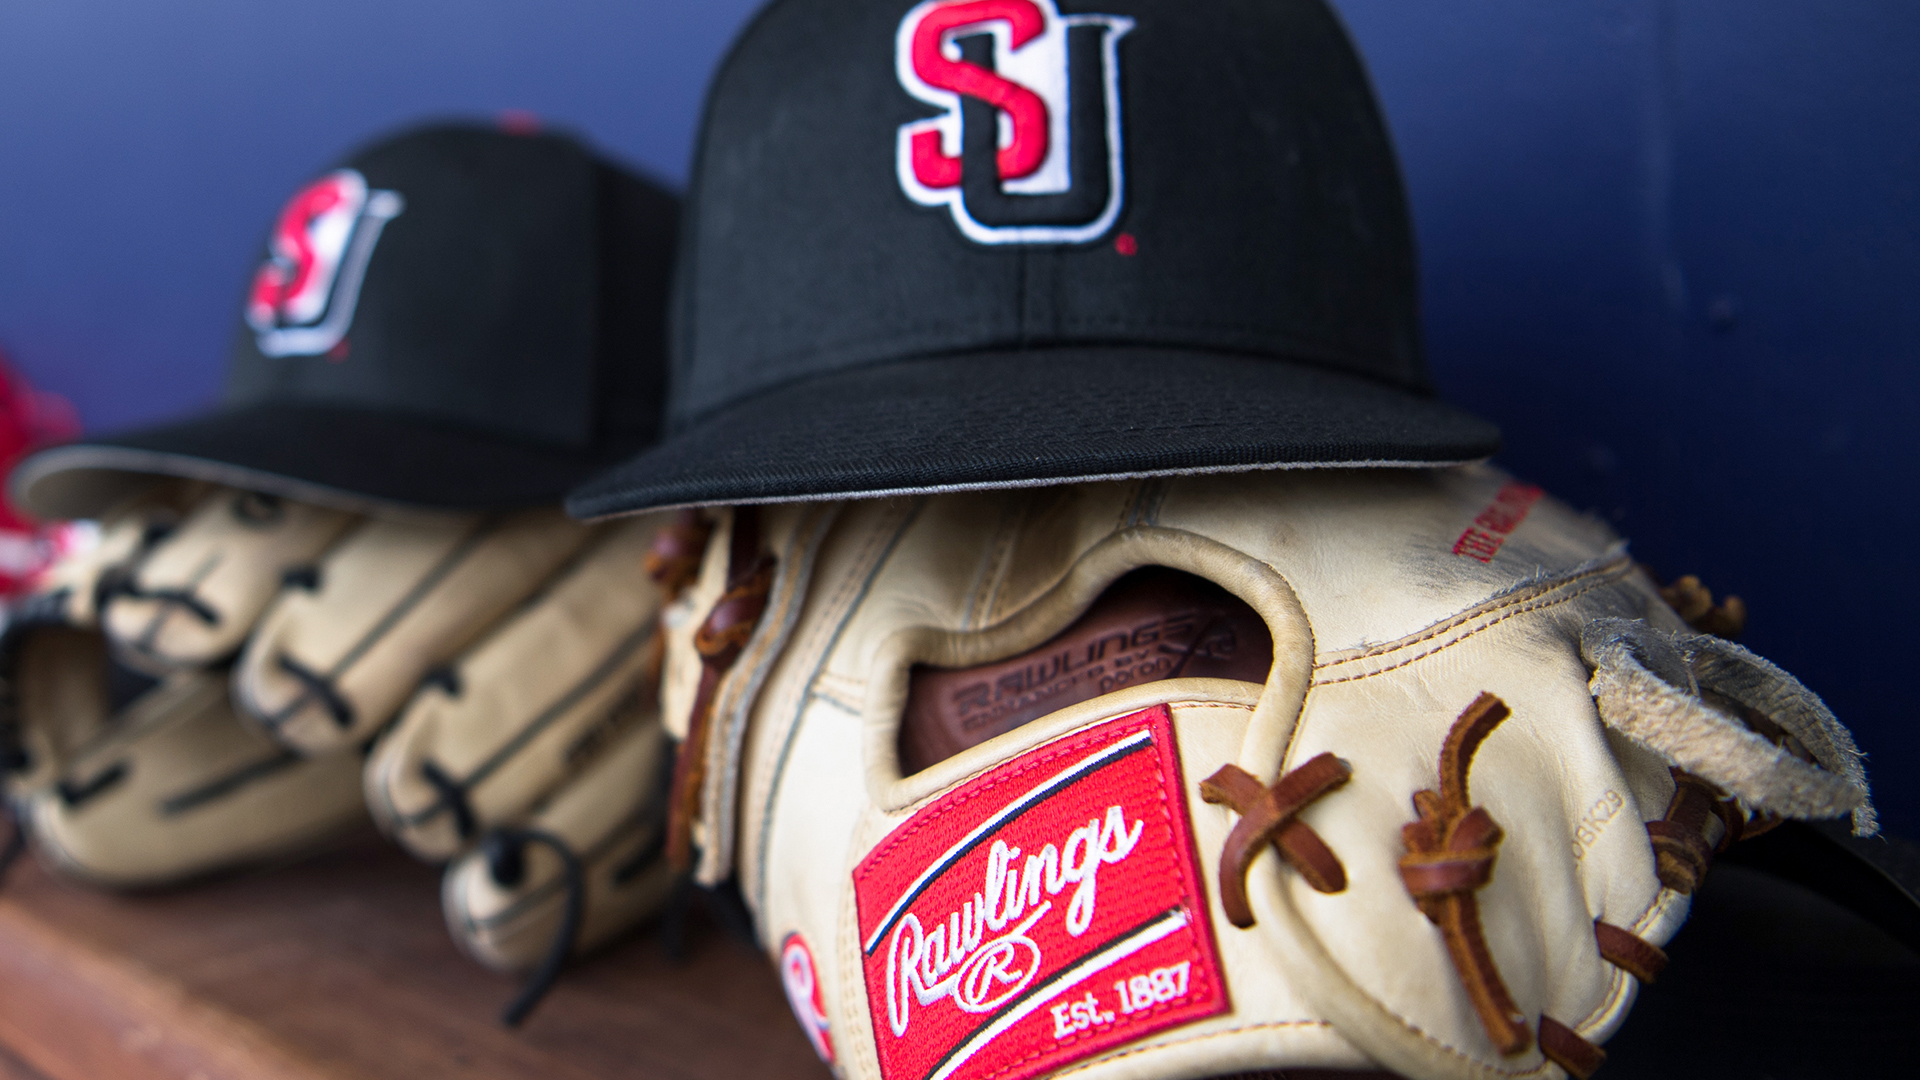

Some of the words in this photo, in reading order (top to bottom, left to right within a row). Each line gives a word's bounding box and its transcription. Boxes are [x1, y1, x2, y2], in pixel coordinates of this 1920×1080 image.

[895, 0, 1135, 245] SU
[953, 613, 1196, 717] RAWLINGS
[1115, 649, 1149, 668] BY
[887, 806, 1144, 1037] Rawlings
[1050, 999, 1115, 1039] Est.
[1115, 961, 1191, 1014] 1887
